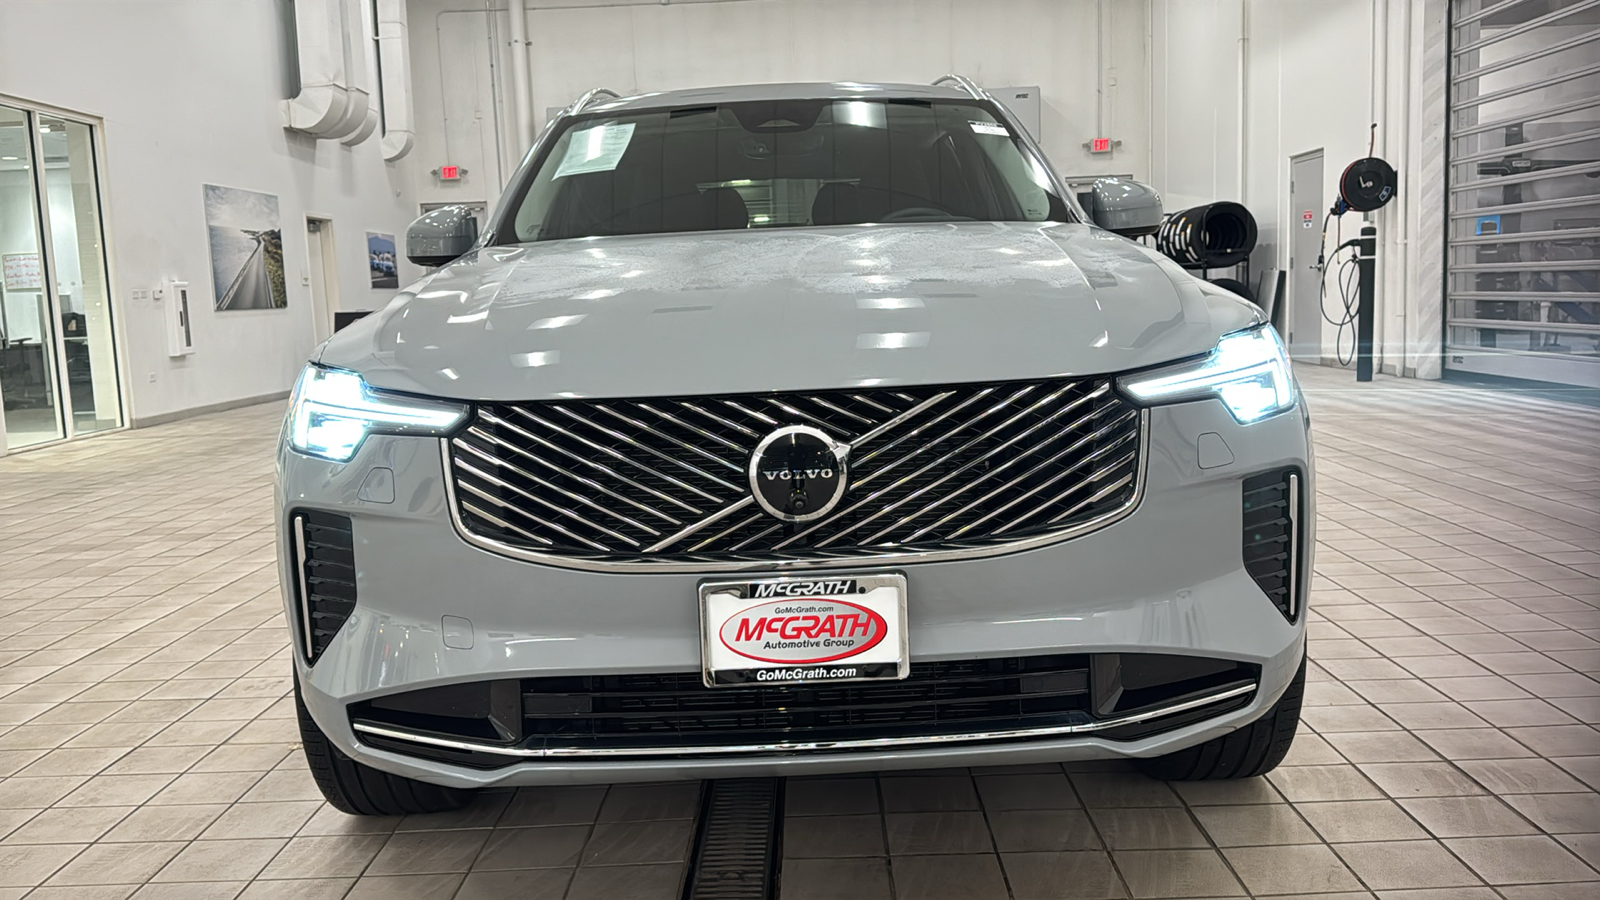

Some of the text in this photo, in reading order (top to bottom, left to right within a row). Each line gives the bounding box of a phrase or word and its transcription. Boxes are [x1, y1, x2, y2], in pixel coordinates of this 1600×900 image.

[1094, 138, 1109, 151] EXIT
[442, 166, 457, 179] EXIT
[763, 468, 833, 480] VOLVO
[774, 605, 834, 615] GoMcGrath.com
[763, 638, 855, 650] Automotive Group
[756, 667, 857, 681] GoMcGrath.com
